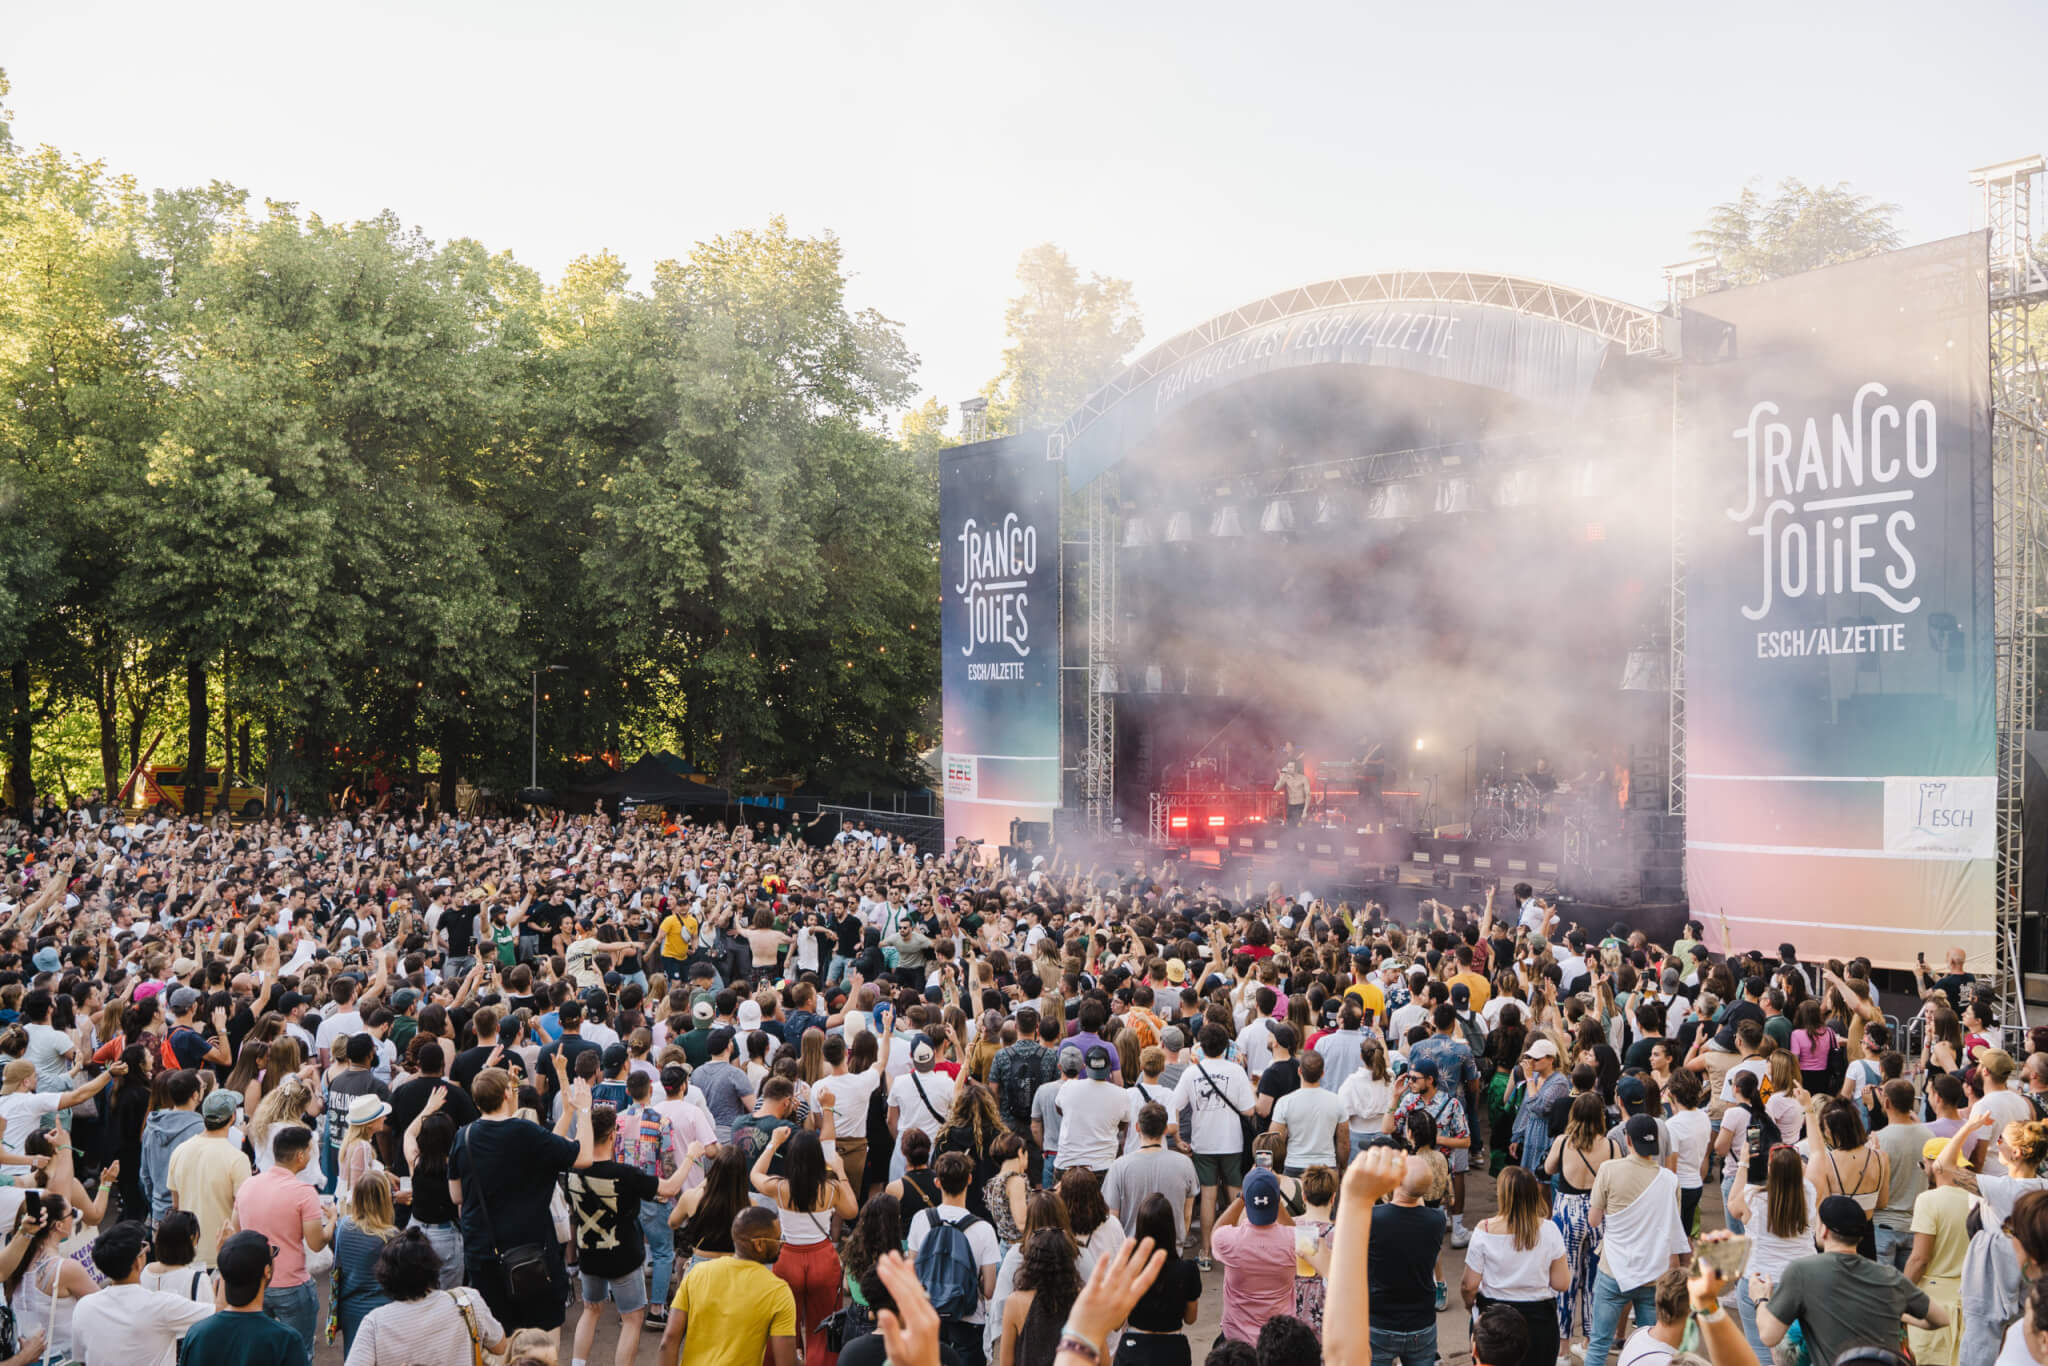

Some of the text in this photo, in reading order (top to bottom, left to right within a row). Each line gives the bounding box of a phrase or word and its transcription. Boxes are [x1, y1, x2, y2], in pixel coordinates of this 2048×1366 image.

[1757, 624, 1905, 659] ESCH/ALZETTE
[968, 661, 1025, 681] ESCH/ALZETTE
[1932, 809, 1974, 828] ESCH
